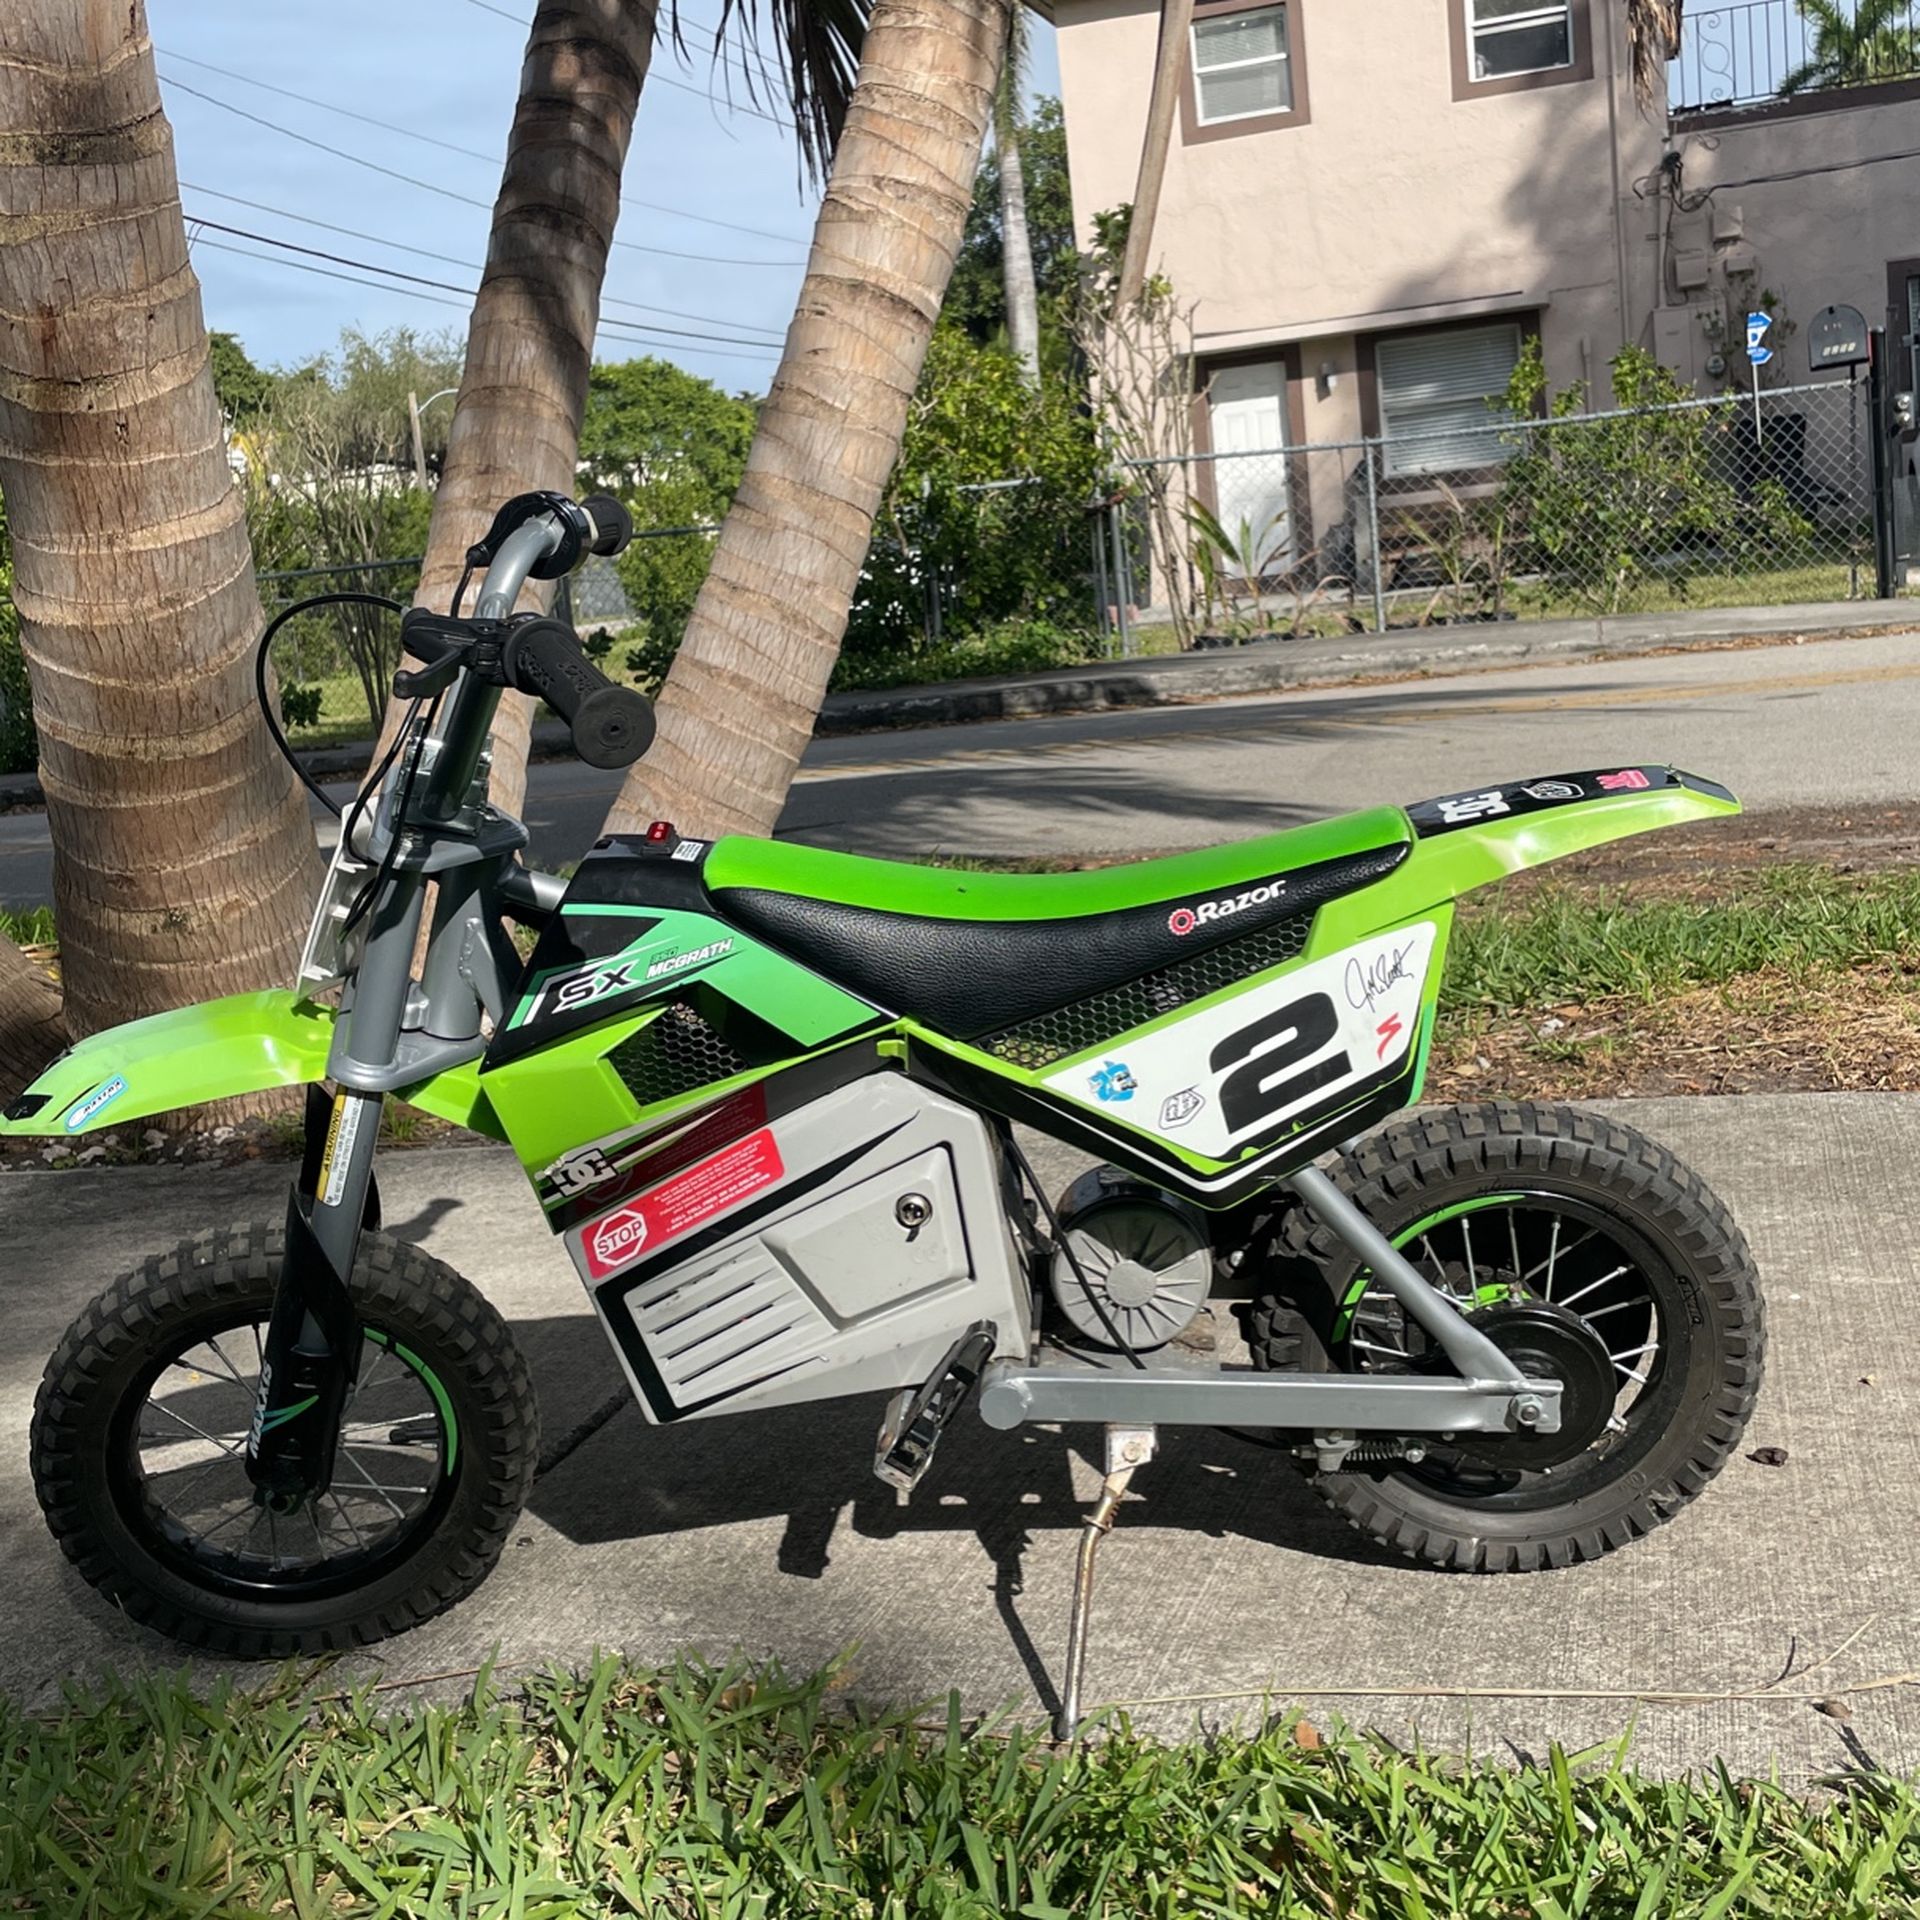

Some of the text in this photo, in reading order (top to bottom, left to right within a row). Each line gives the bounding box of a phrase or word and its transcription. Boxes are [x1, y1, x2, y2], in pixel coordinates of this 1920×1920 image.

[1196, 880, 1286, 925] Razor
[646, 937, 734, 979] MCGRATH
[555, 959, 639, 1011] SX
[1209, 991, 1353, 1135] 2
[325, 1108, 341, 1161] WARNING
[597, 1220, 642, 1255] STOP
